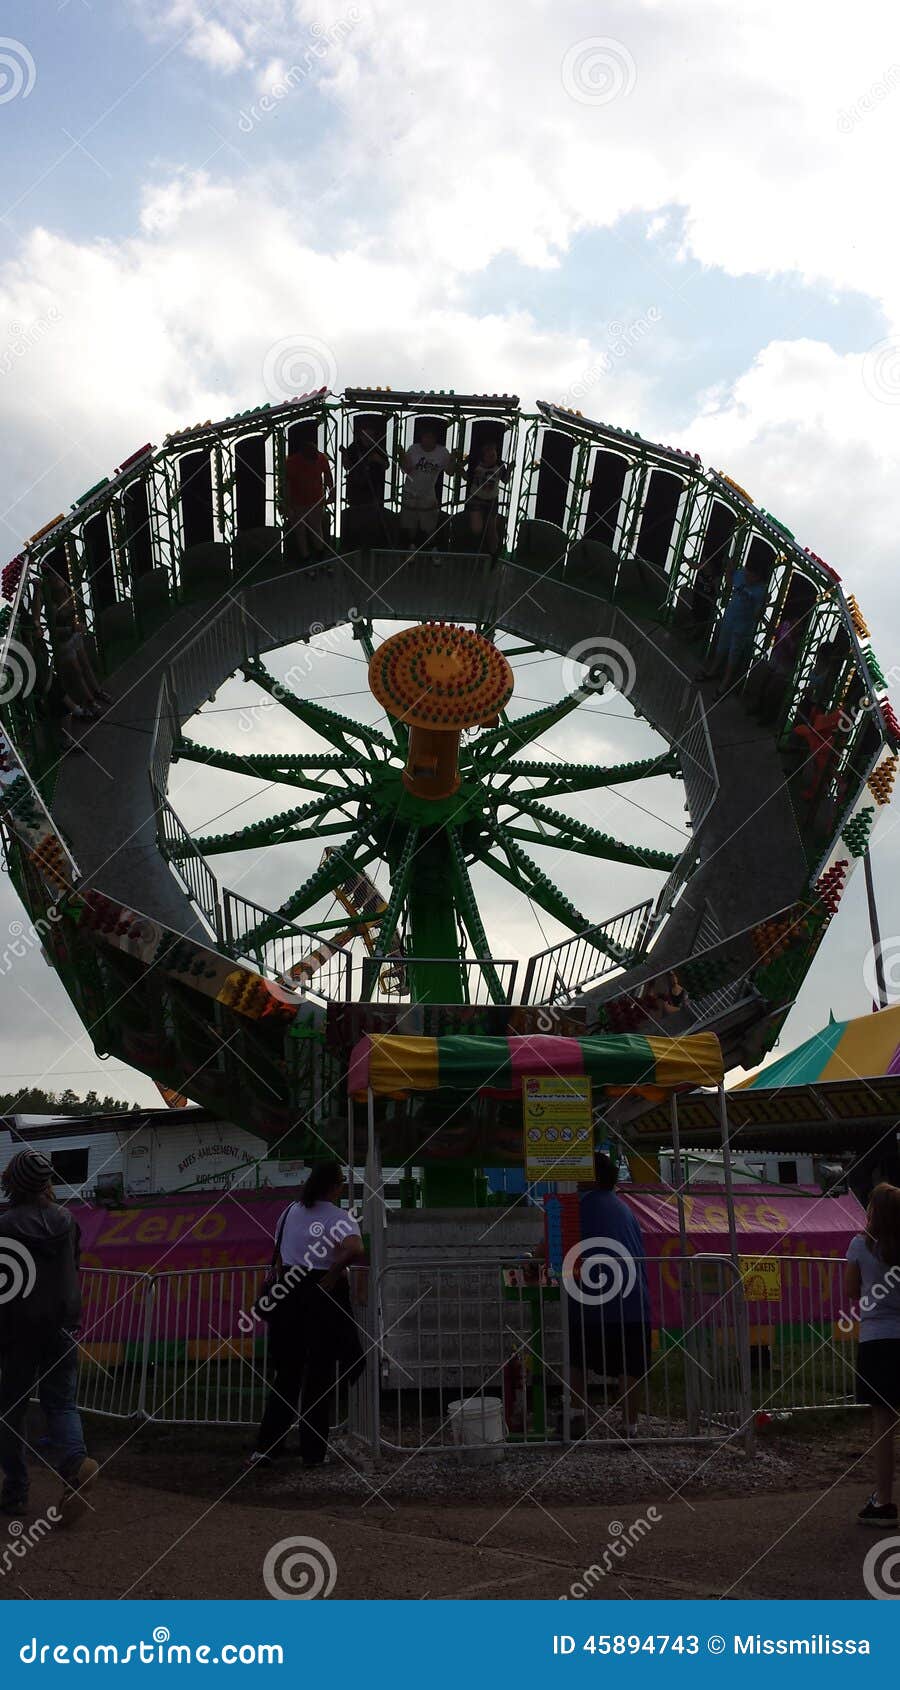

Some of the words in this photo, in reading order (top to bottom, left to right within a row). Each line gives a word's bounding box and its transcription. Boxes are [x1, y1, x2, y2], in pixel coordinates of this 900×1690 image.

[96, 1209, 227, 1246] Zero
[665, 1194, 788, 1232] Zero
[751, 1262, 775, 1272] TICKETS
